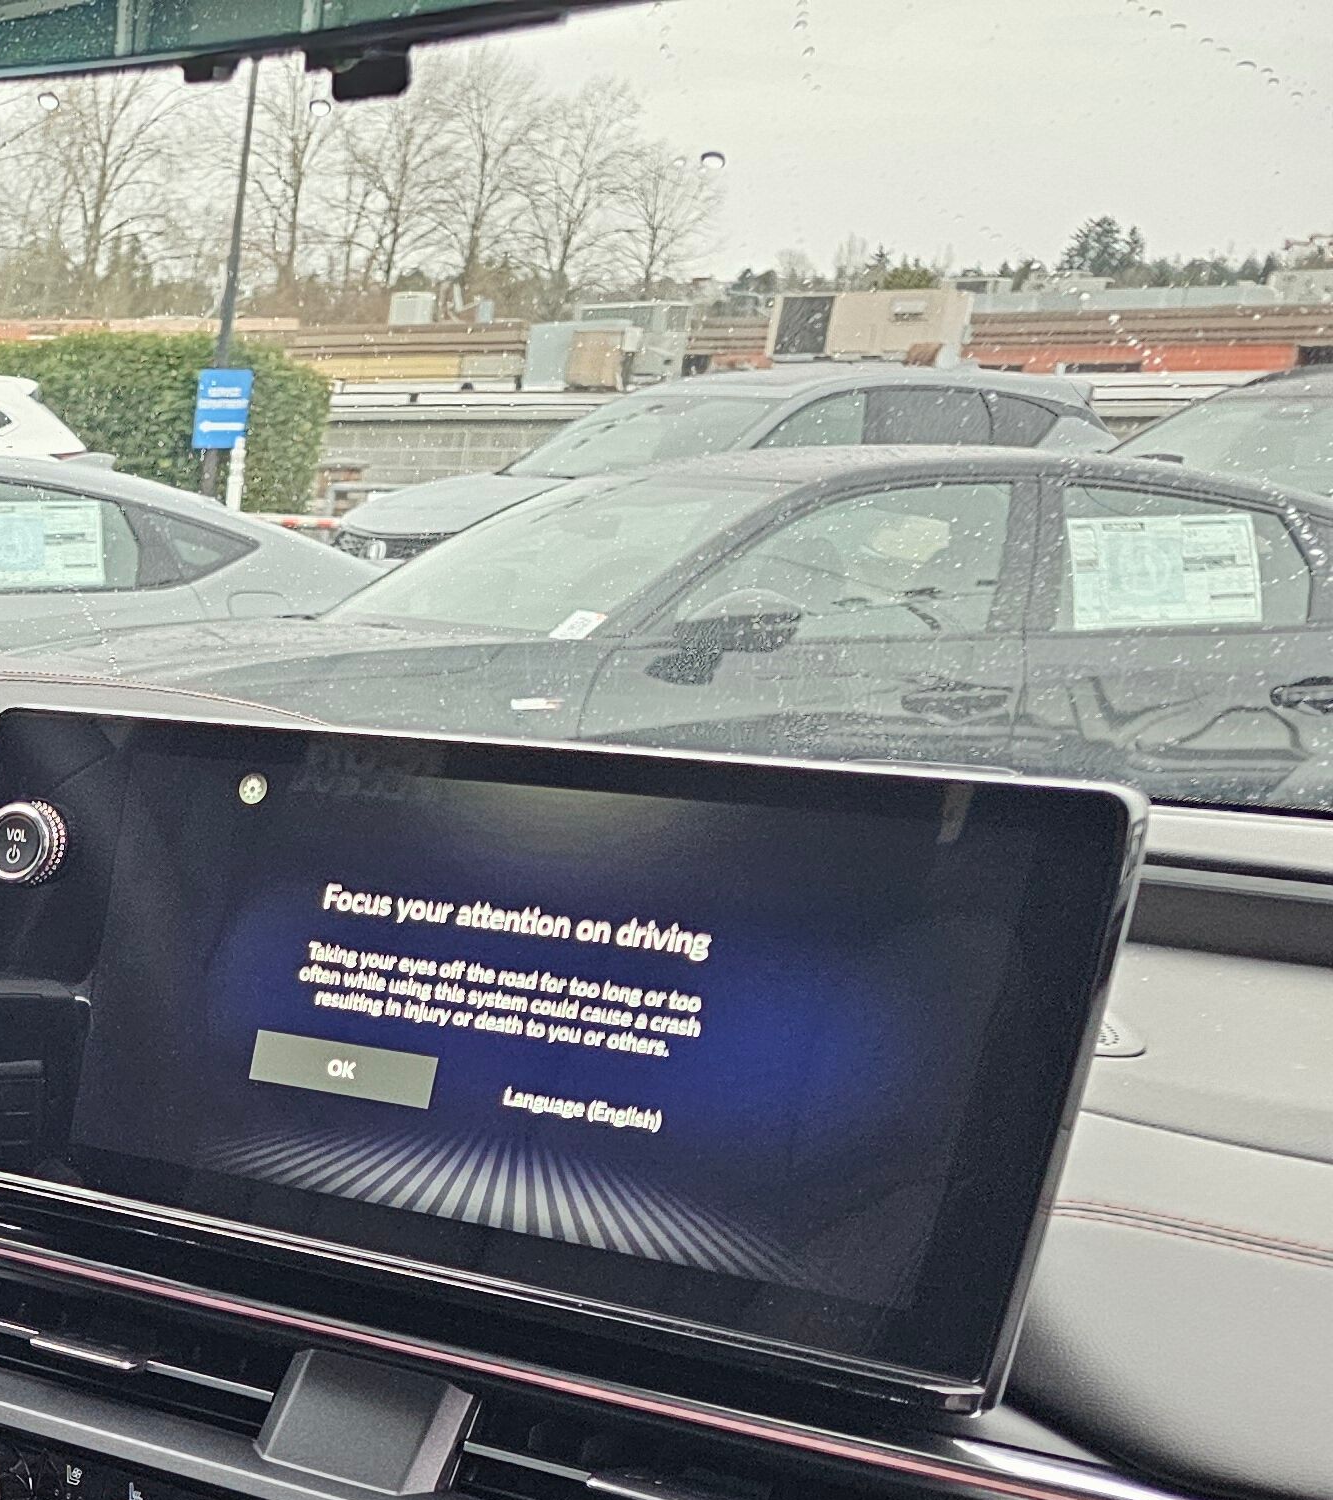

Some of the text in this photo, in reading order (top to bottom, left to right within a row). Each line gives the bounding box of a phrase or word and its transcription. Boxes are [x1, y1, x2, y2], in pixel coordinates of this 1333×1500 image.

[6, 827, 27, 843] VOL
[323, 882, 712, 962] Focus your attention on driving
[299, 963, 702, 1038] often while using this system could cause a crash
[308, 940, 702, 1013] Taking your eyes off the road for too long or too
[314, 990, 670, 1058] resulting in injury or death to you or others.
[327, 1059, 357, 1080] OK
[503, 1085, 663, 1133] Language (English)
